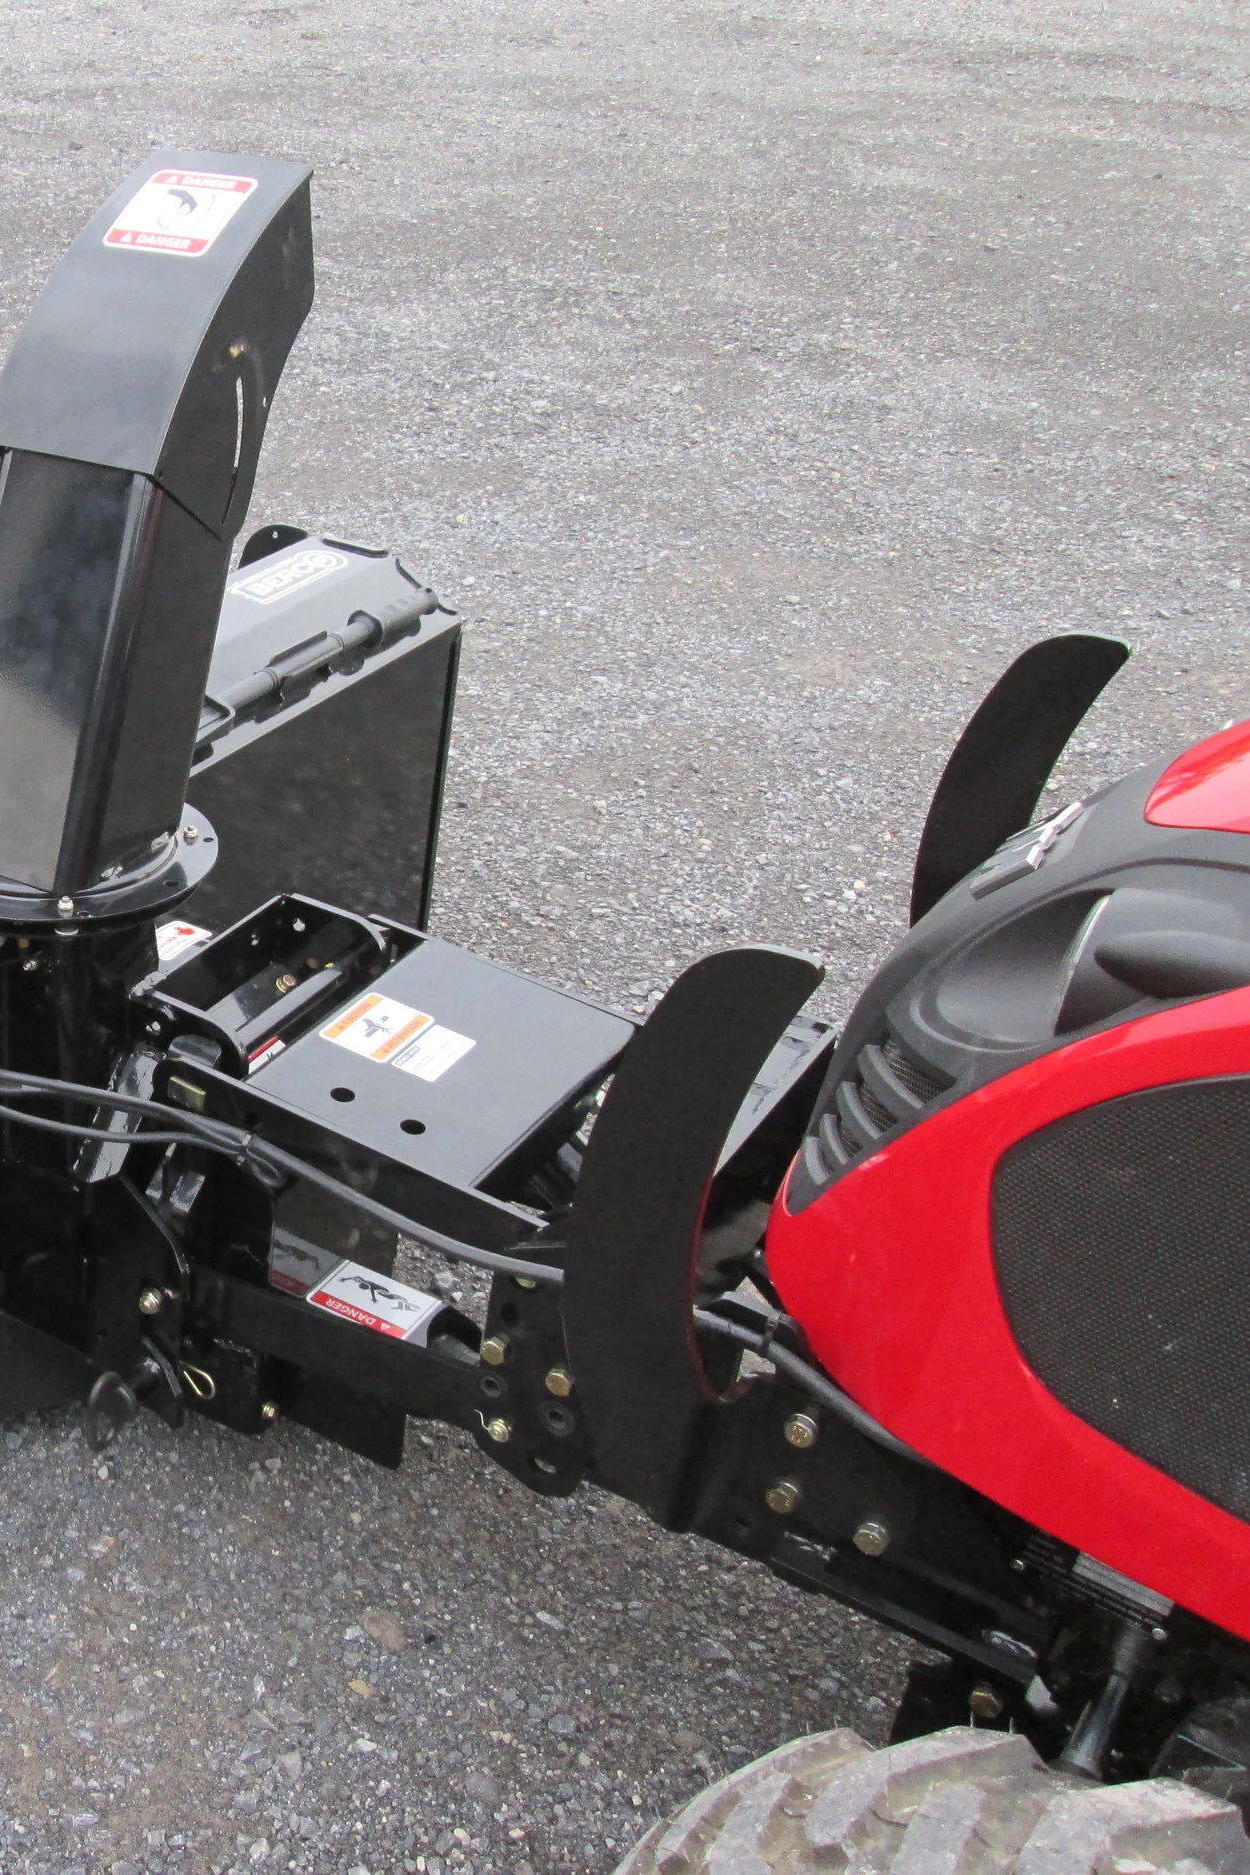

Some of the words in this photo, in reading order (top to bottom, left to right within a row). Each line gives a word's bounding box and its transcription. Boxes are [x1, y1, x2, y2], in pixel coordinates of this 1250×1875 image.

[181, 175, 237, 190] DANGER
[136, 233, 191, 249] DANGER
[325, 1298, 376, 1326] DANGER
